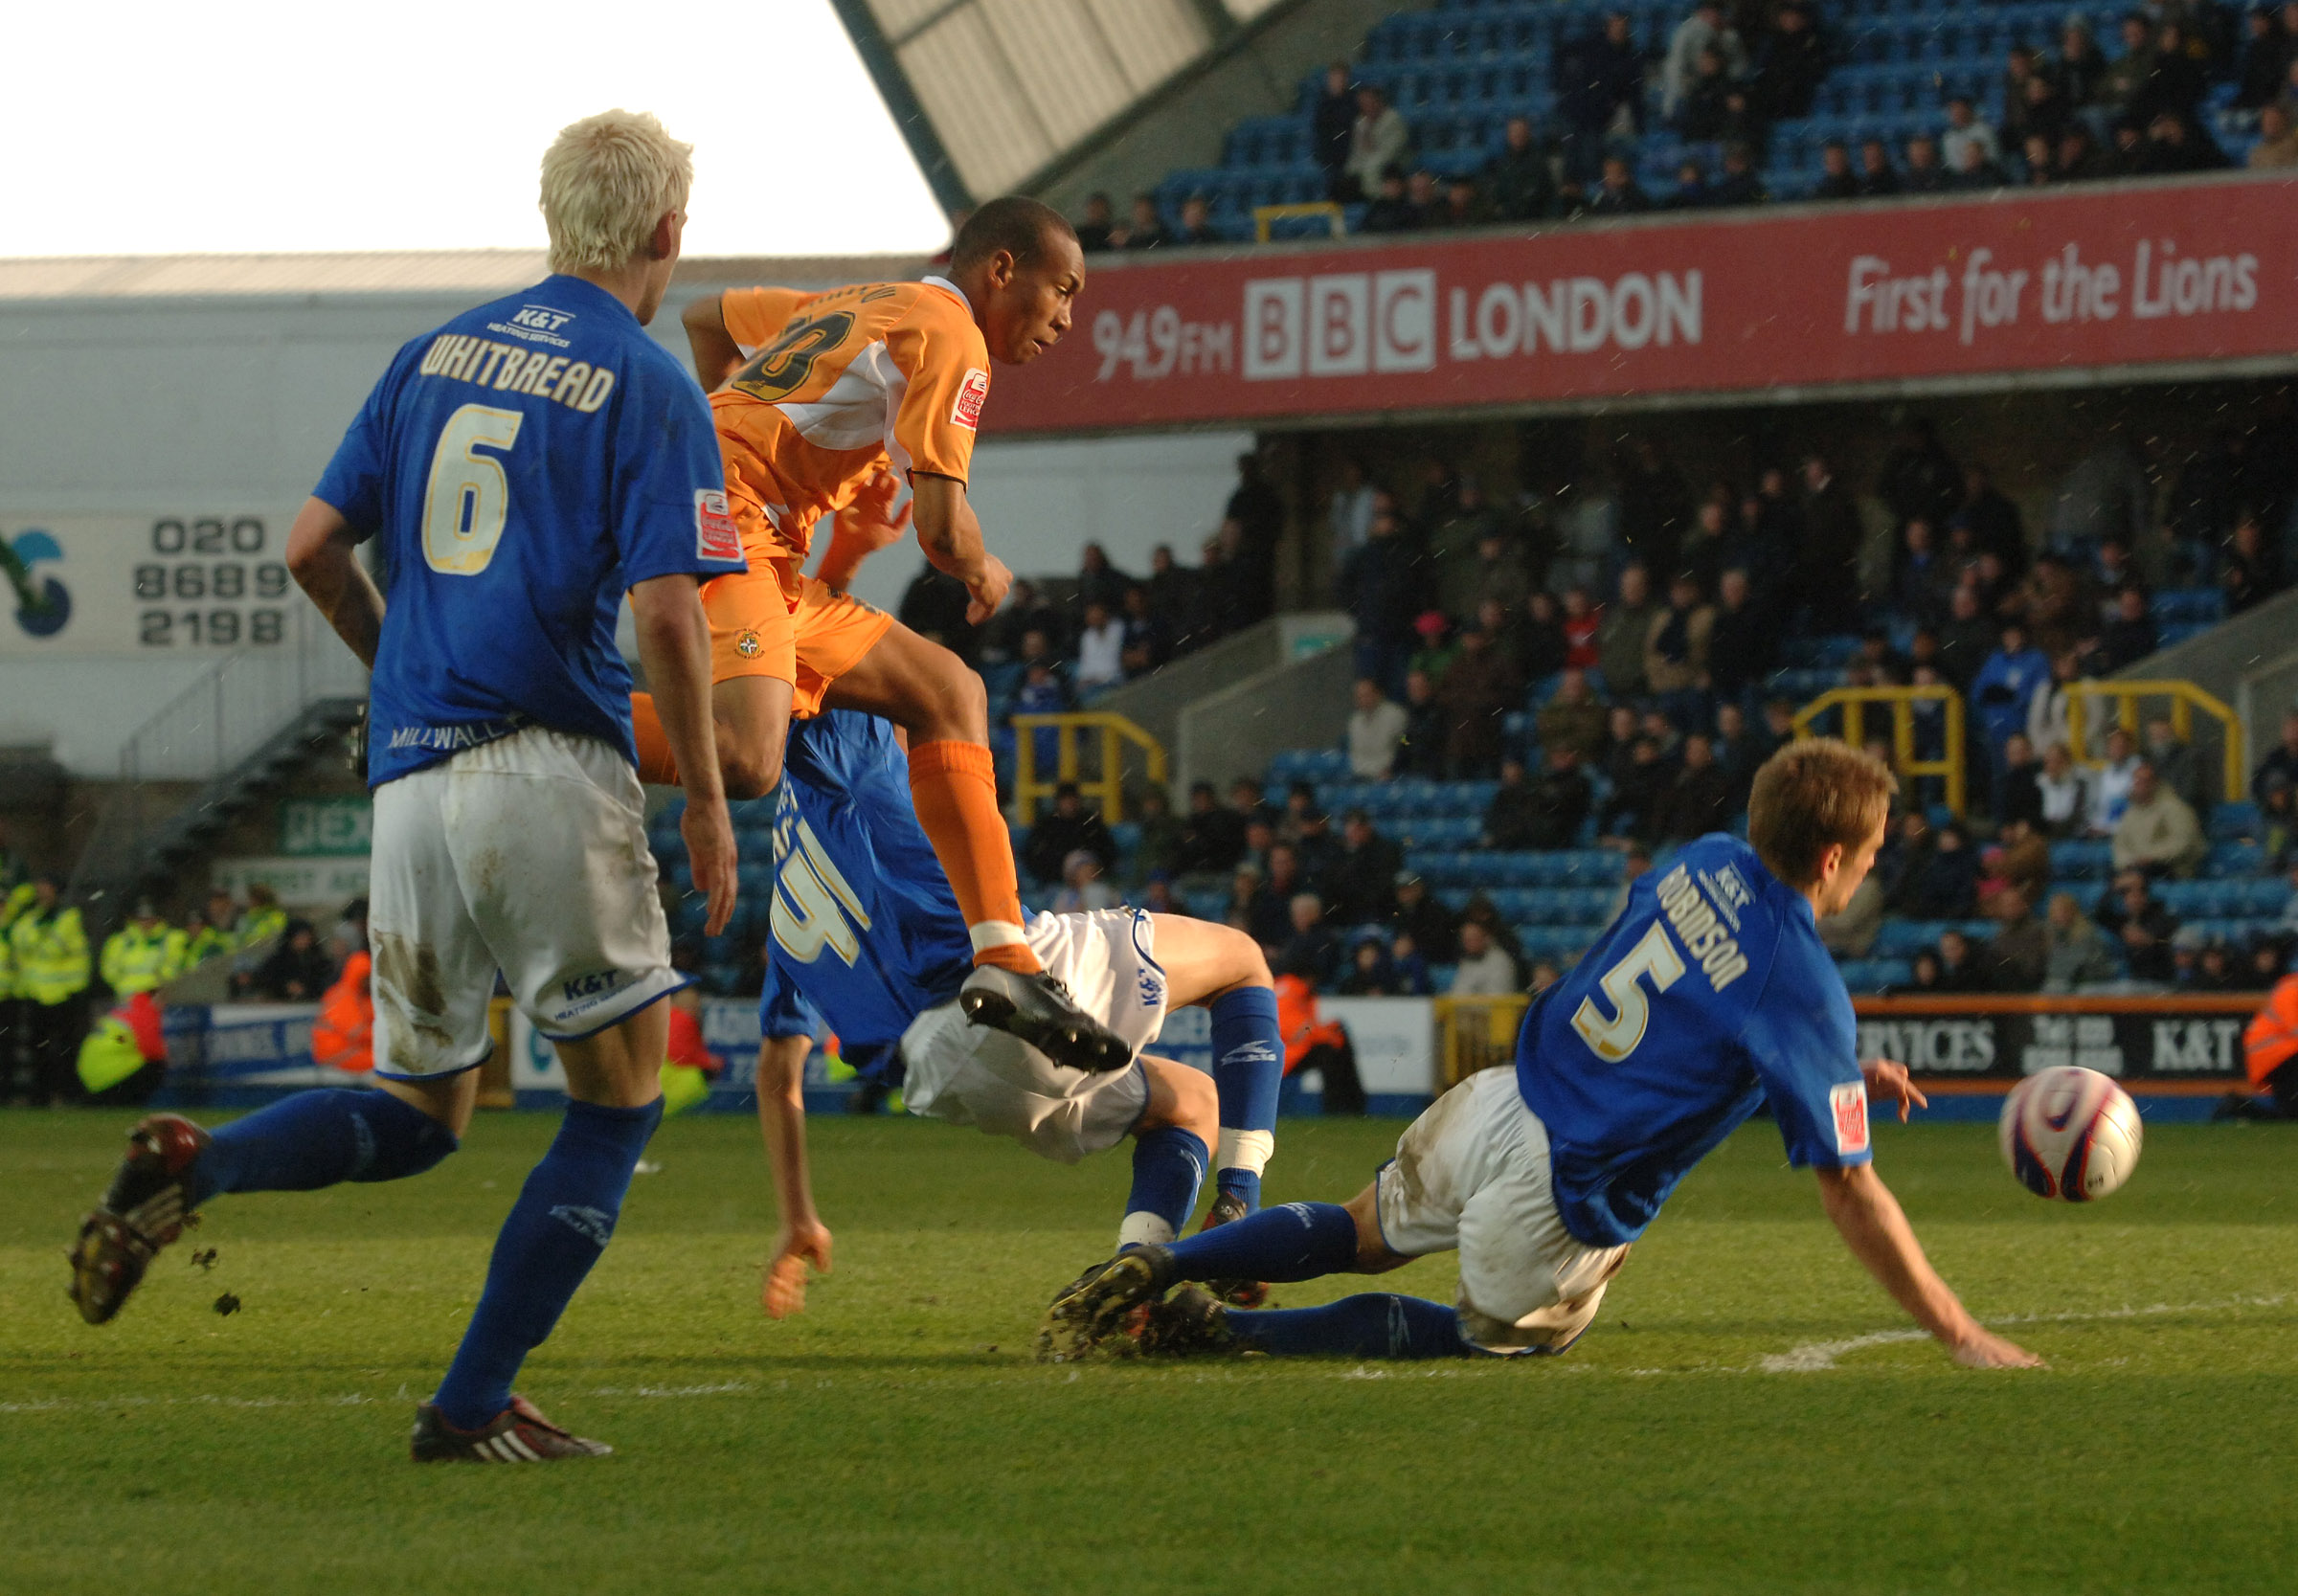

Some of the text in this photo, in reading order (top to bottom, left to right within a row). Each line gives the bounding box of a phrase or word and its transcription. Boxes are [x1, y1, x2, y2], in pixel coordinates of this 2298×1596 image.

[1843, 238, 2259, 346] First for the Lions
[512, 308, 570, 330] K&T
[1250, 278, 1429, 374] BBC
[1450, 268, 1702, 361] LONDON
[419, 334, 615, 413] WHITBREAD
[421, 403, 524, 575] 6
[152, 518, 265, 553] 020
[135, 563, 290, 600] 8689
[140, 610, 284, 645] 2198
[388, 723, 505, 749] MILLWALL
[1656, 862, 1748, 993] ROBINSON
[564, 969, 618, 1001] K&T
[1570, 918, 1686, 1064] 5
[2152, 1020, 2241, 1070] K&T
